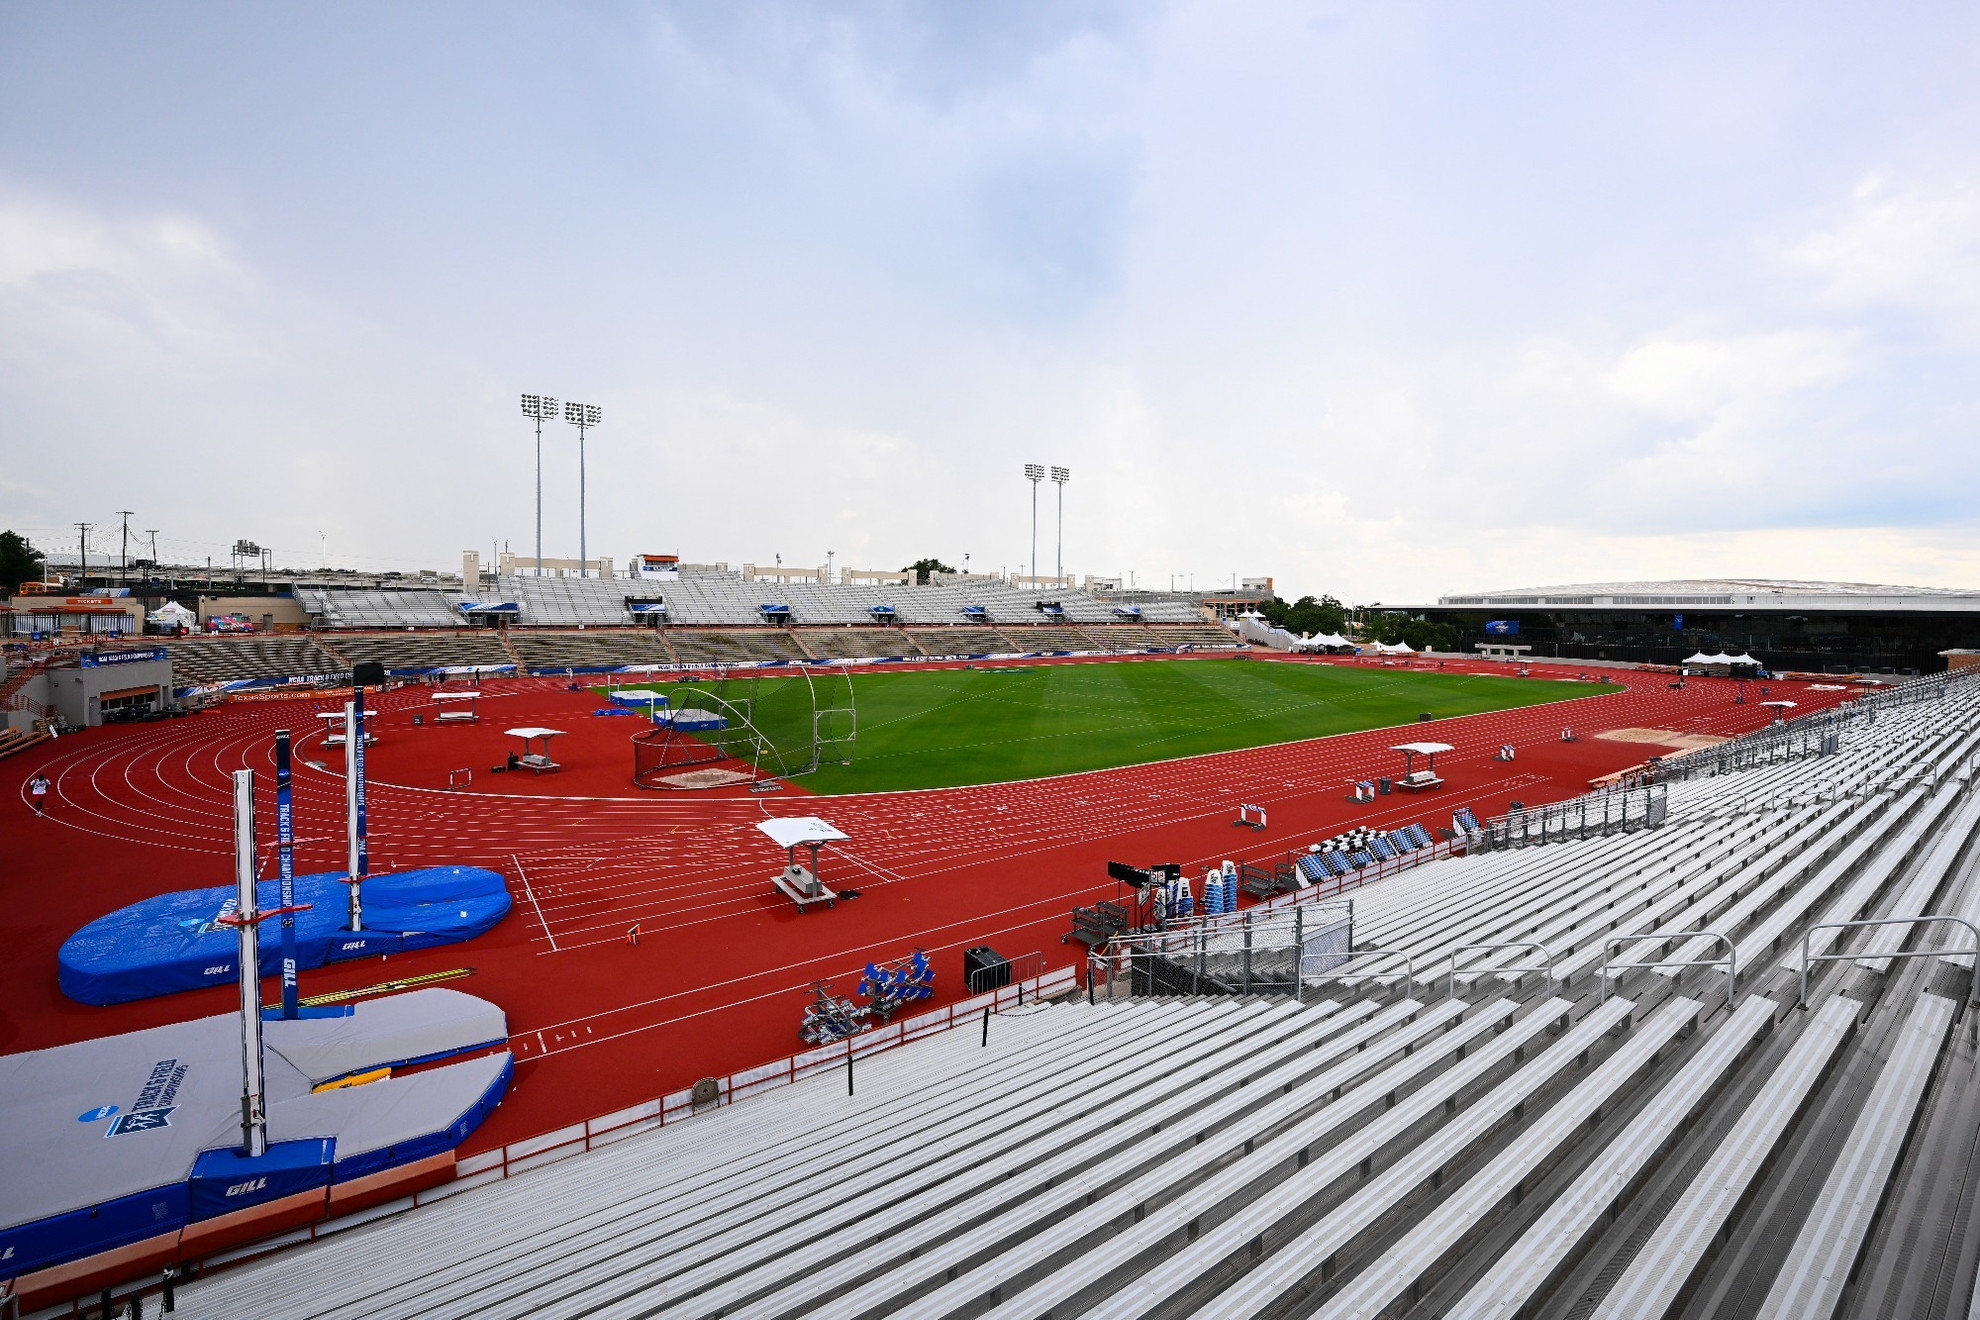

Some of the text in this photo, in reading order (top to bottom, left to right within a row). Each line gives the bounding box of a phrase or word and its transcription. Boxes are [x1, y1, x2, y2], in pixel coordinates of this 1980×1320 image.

[232, 692, 311, 701] TexasSports.com
[279, 803, 290, 829] TRACK
[342, 940, 367, 951] GILL
[203, 964, 231, 976] GILL
[283, 957, 296, 988] GILL
[225, 1176, 268, 1197] GILL
